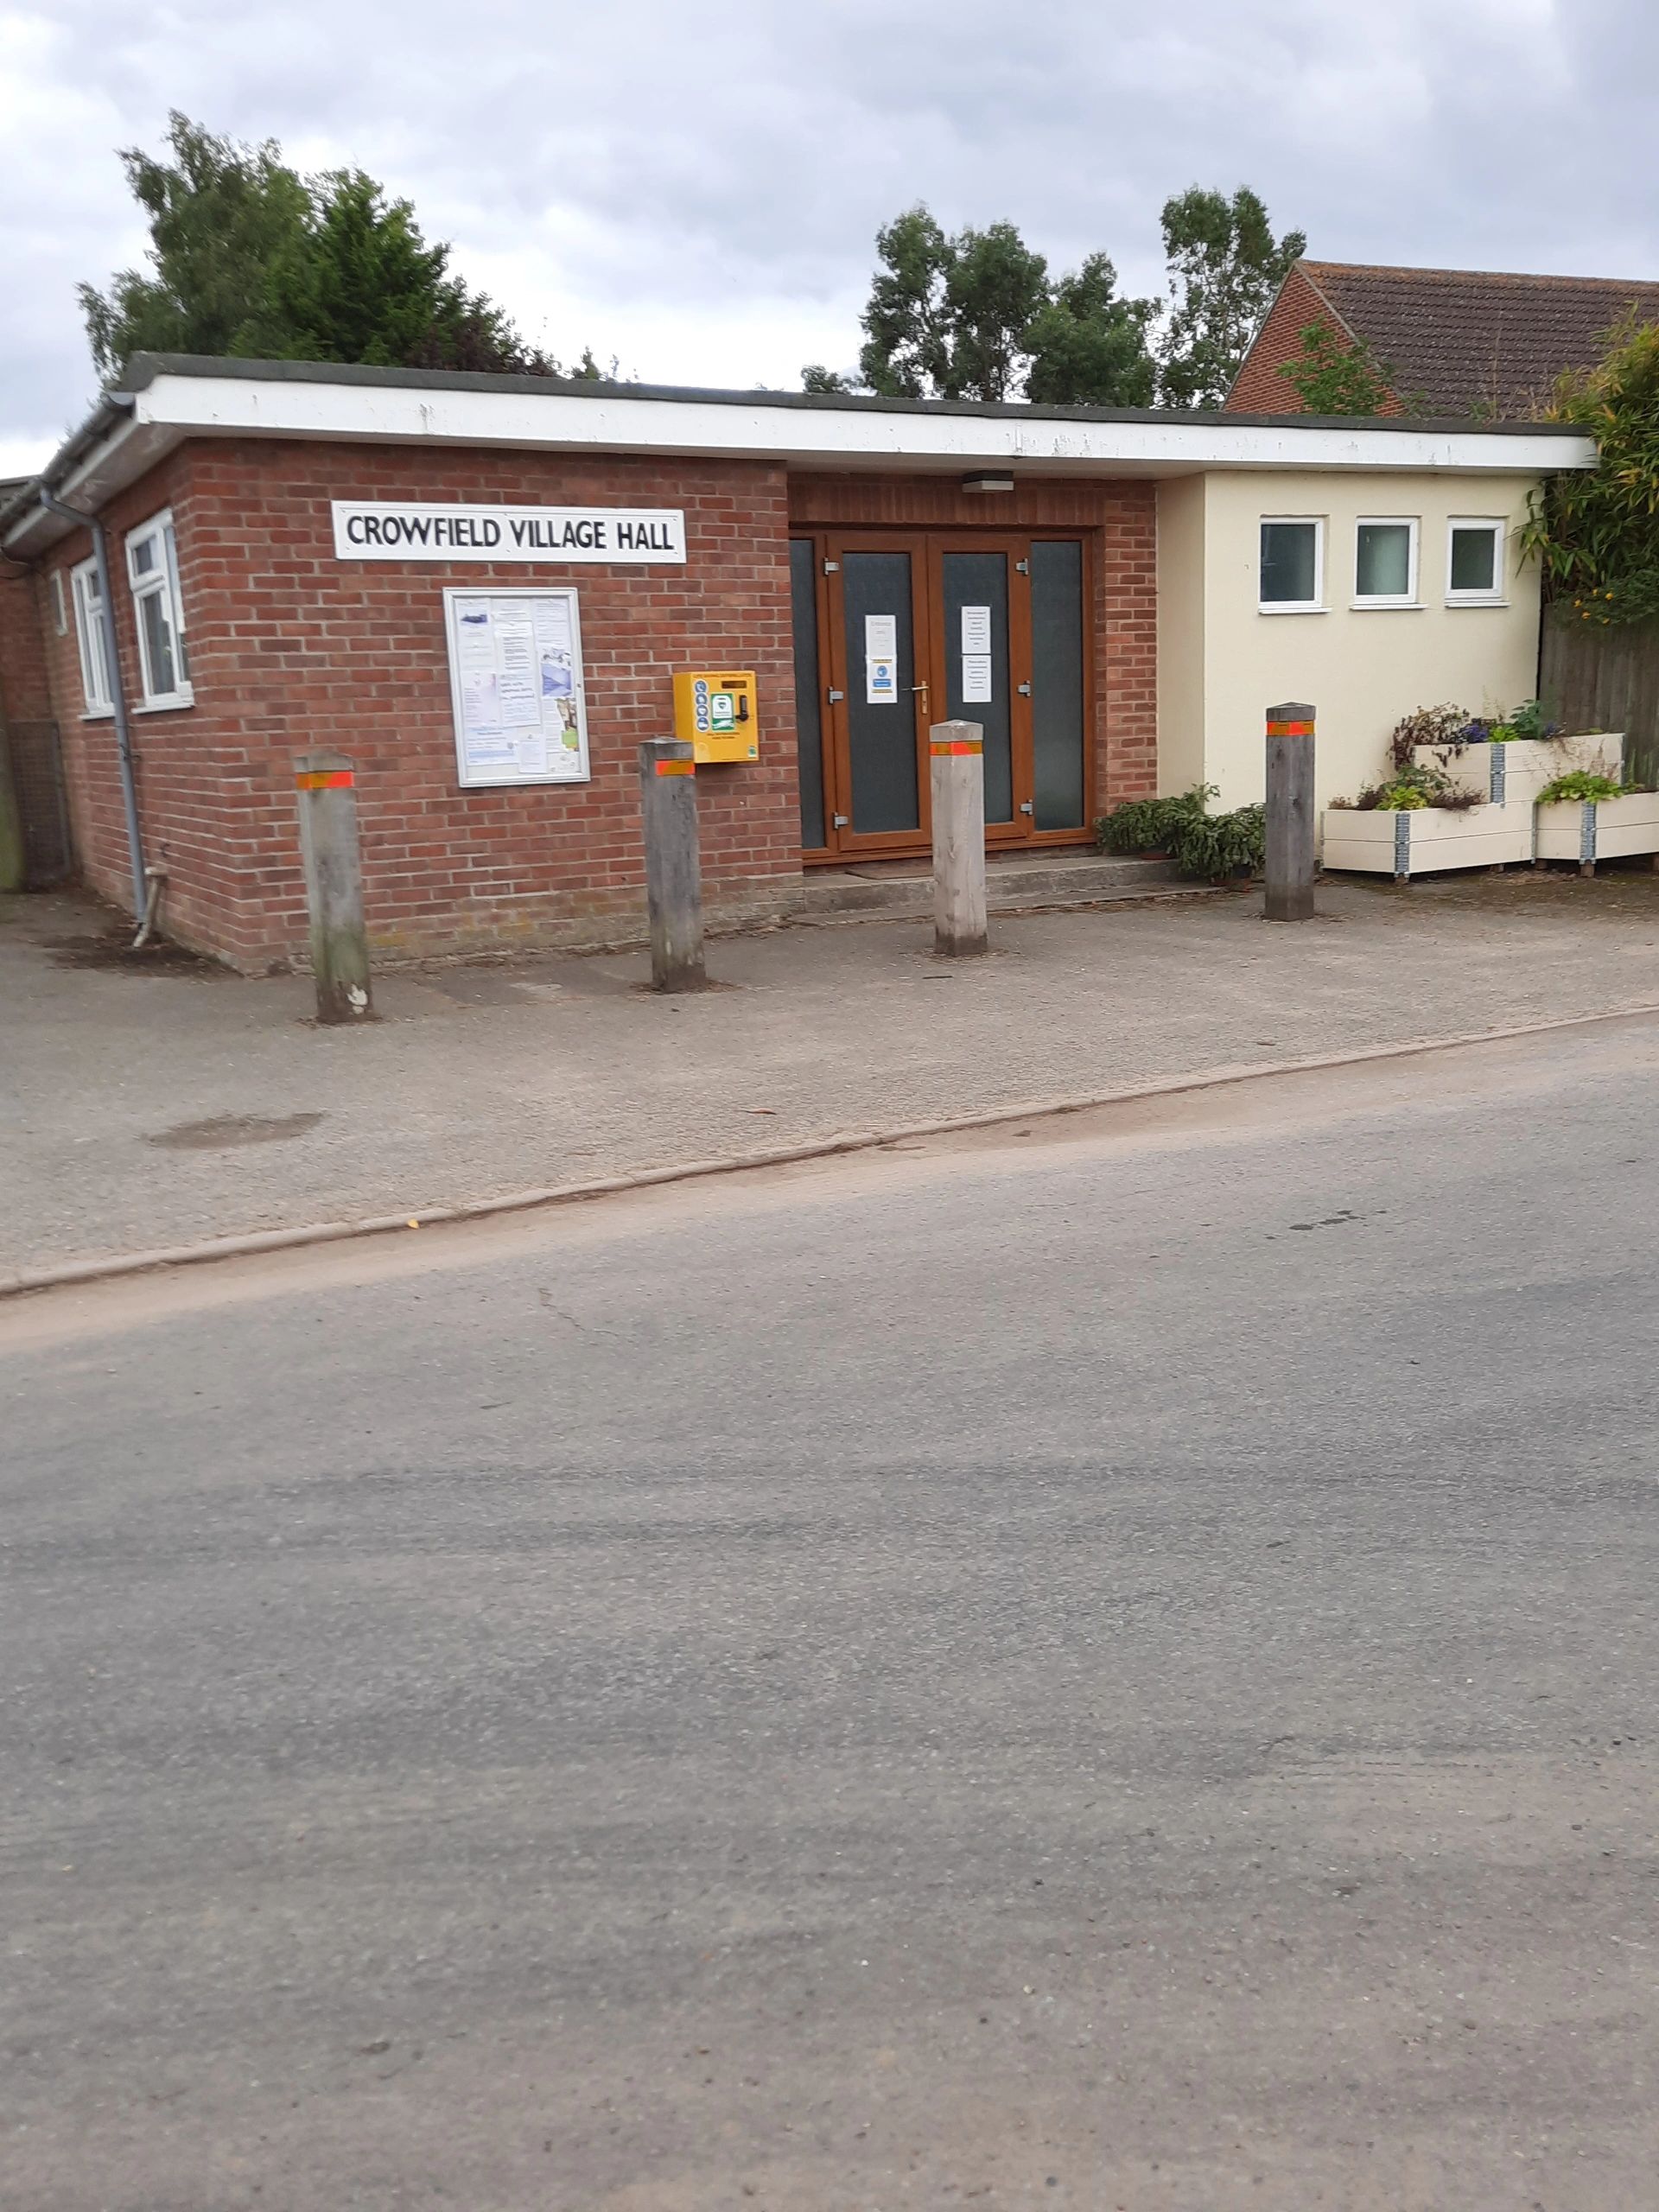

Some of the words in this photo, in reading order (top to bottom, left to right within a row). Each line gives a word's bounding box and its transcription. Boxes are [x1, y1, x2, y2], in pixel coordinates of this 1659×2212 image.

[346, 516, 500, 547] CROWFIELD
[510, 519, 607, 549] VILLAGE
[617, 522, 674, 550] HALL
